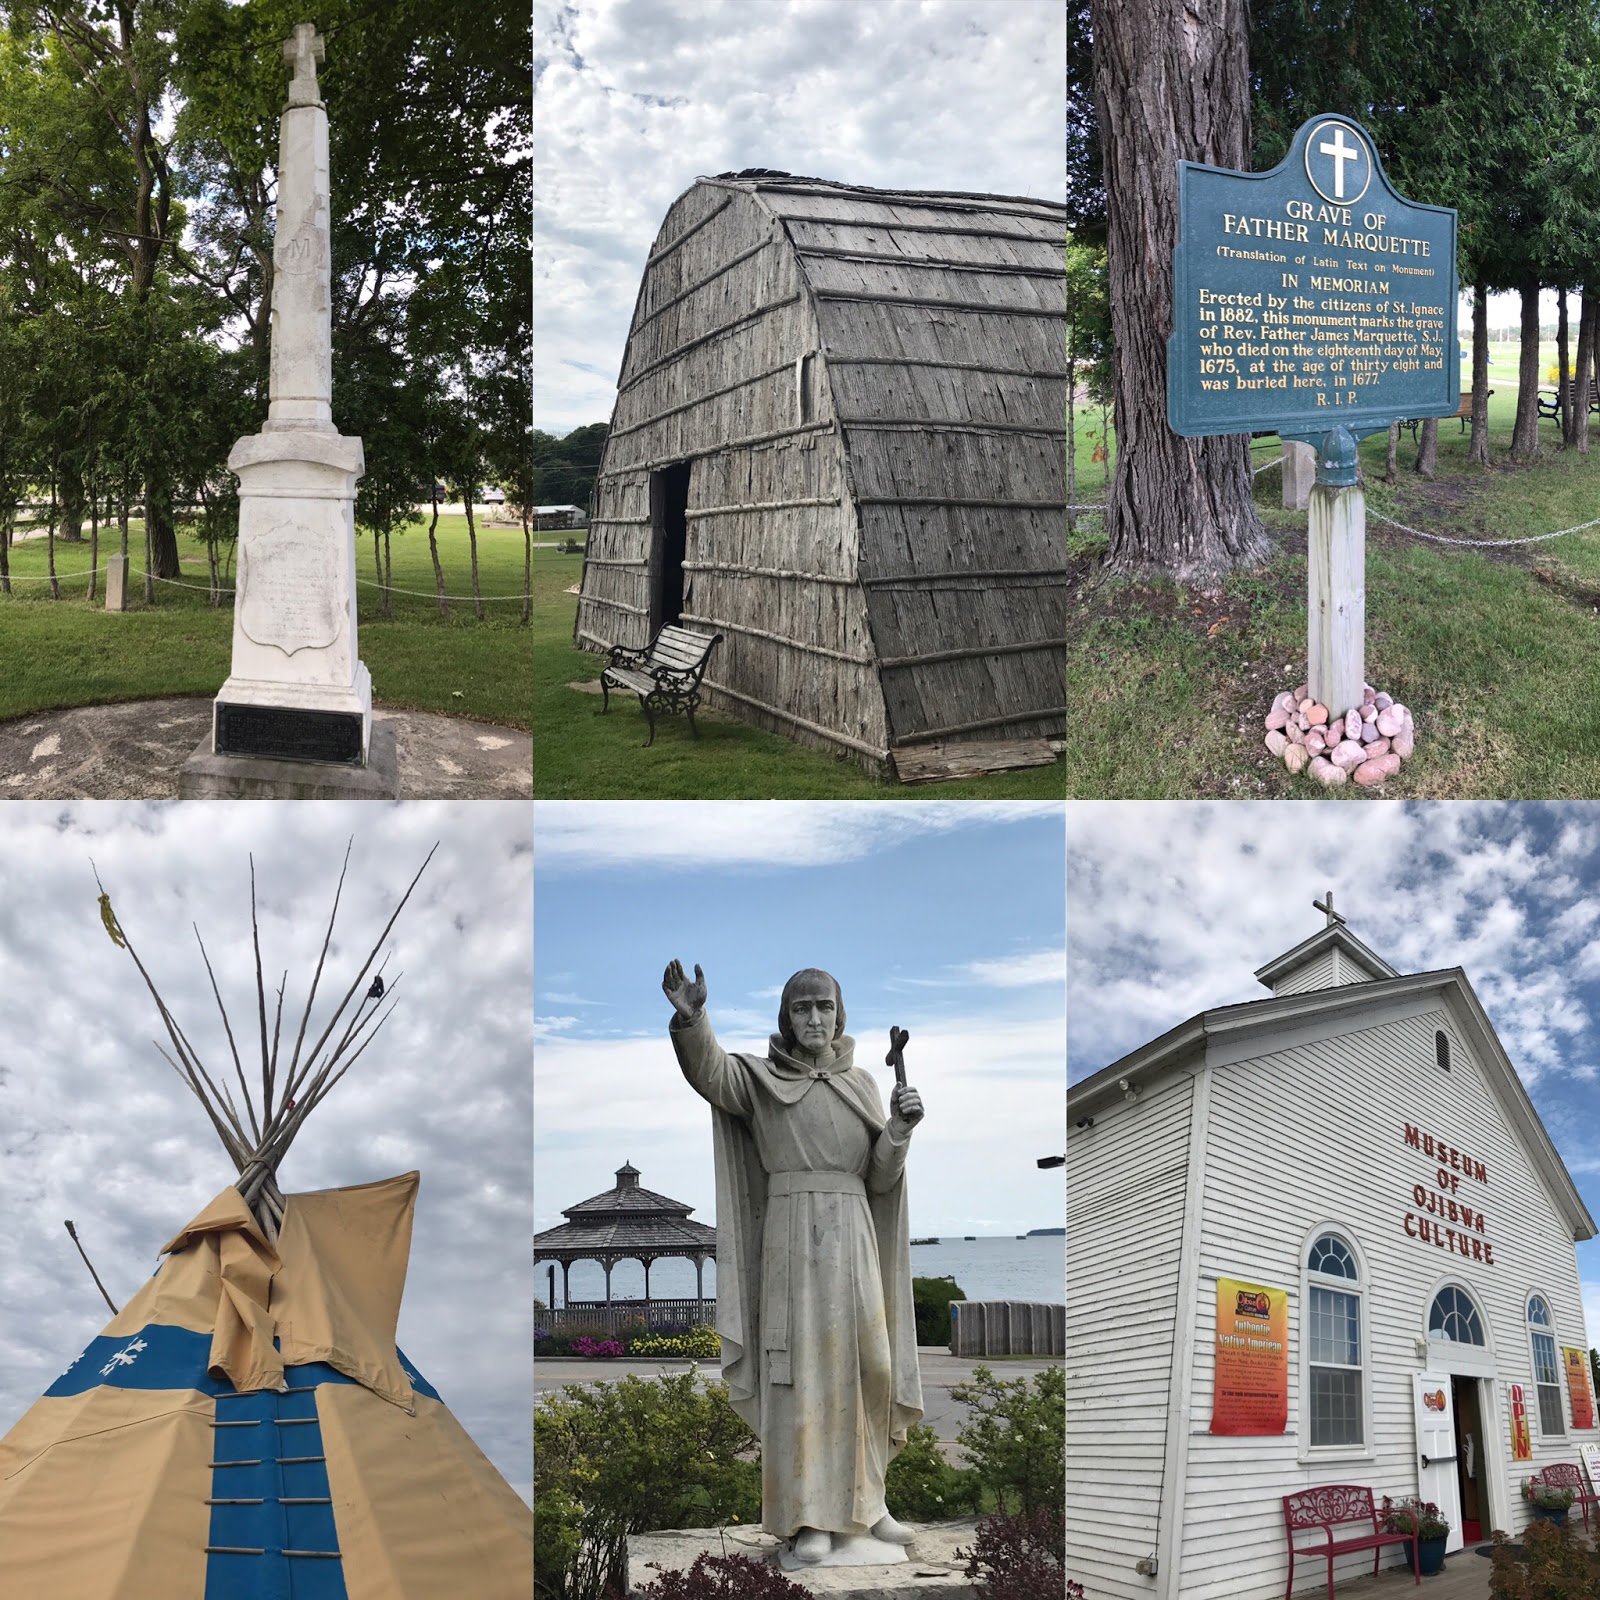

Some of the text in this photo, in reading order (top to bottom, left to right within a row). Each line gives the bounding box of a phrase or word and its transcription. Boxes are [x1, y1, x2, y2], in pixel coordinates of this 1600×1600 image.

[1286, 200, 1386, 230] GRAVE OF
[1223, 214, 1431, 257] FATHER MARQUETTE
[1217, 246, 1435, 276] (Translation of Latin Text on Monument)
[1282, 273, 1389, 294] IN MEMORIAM
[1199, 289, 1444, 317] Erected by the citizens of St. Ignace
[1200, 308, 1444, 330] in 1882, this monument marks the grave
[1200, 325, 1218, 339] of
[1224, 325, 1256, 339] Rev.
[1261, 326, 1306, 340] Father
[1311, 328, 1349, 341] James
[1200, 342, 1232, 356] who
[1237, 343, 1269, 356] died
[1272, 346, 1289, 356] on
[1292, 344, 1314, 356] the
[1318, 344, 1381, 358] eighteenth
[1384, 345, 1404, 358] day
[1406, 345, 1418, 356] of
[1200, 358, 1443, 374] 1675, at the age of thirty eight and
[1201, 380, 1229, 391] was
[1236, 376, 1287, 389] buried
[1334, 376, 1346, 386] in
[1353, 373, 1380, 385] 1677.
[1317, 392, 1357, 406] R. I. P.
[1404, 1122, 1487, 1184] MUSEUM
[1437, 1168, 1460, 1195] OF
[1413, 1184, 1485, 1234] OJIBWA
[1404, 1212, 1494, 1265] CULTURE
[1234, 1320, 1271, 1337] Authentic
[1219, 1334, 1282, 1354] Native American
[1511, 1385, 1528, 1458] OPEN
